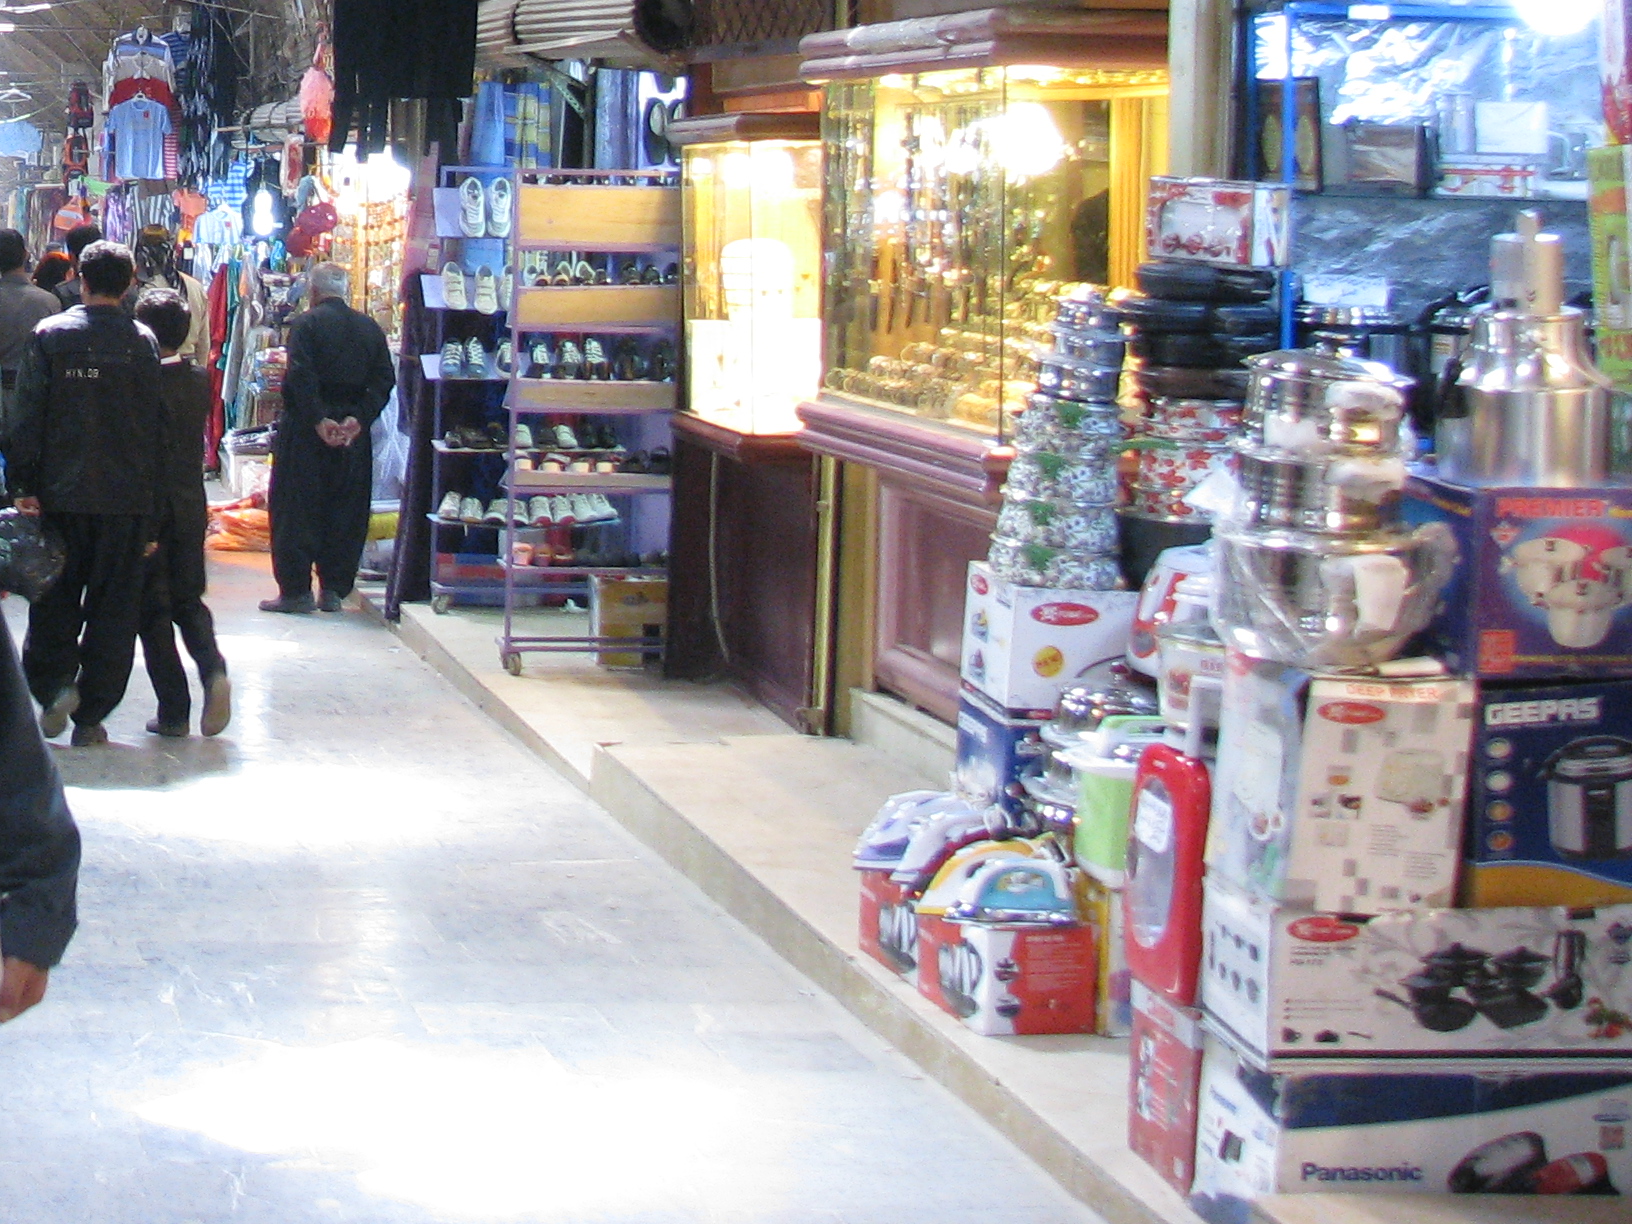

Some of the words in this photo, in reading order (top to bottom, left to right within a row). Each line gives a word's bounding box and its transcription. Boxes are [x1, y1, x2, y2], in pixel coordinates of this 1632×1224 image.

[1495, 497, 1605, 519] PREMIER
[1484, 696, 1602, 726] GEEPAS
[1300, 1162, 1426, 1182] Panasonic
